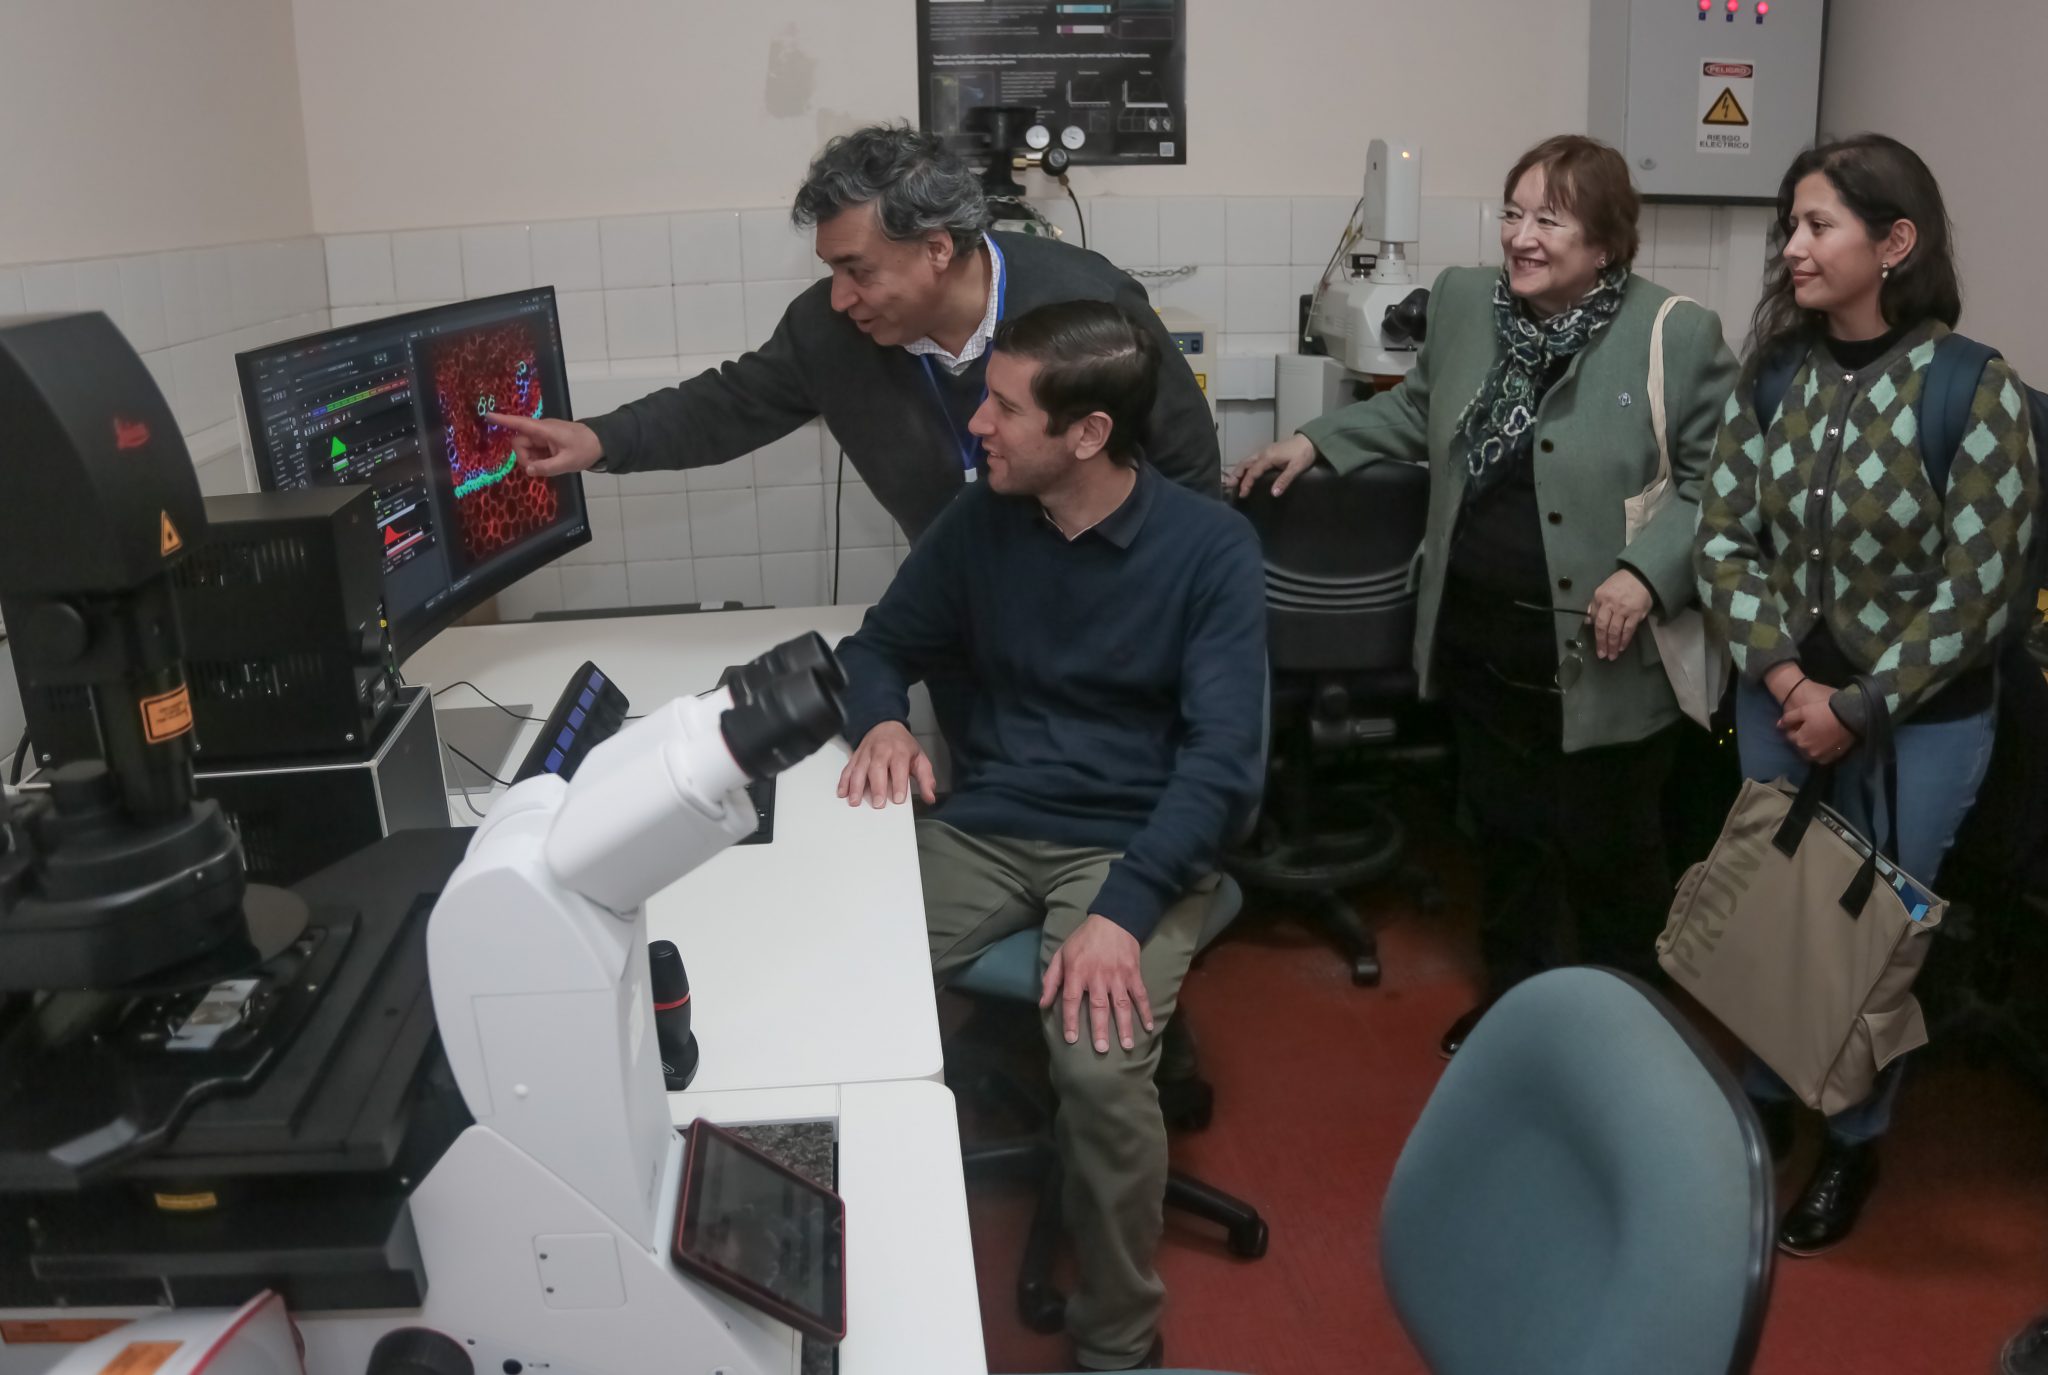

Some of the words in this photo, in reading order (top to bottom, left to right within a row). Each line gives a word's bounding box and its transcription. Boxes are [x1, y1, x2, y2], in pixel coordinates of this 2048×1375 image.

[1709, 65, 1747, 74] PELIGRO
[1706, 134, 1740, 142] RIESGO
[1699, 141, 1749, 149] ELECTRICO
